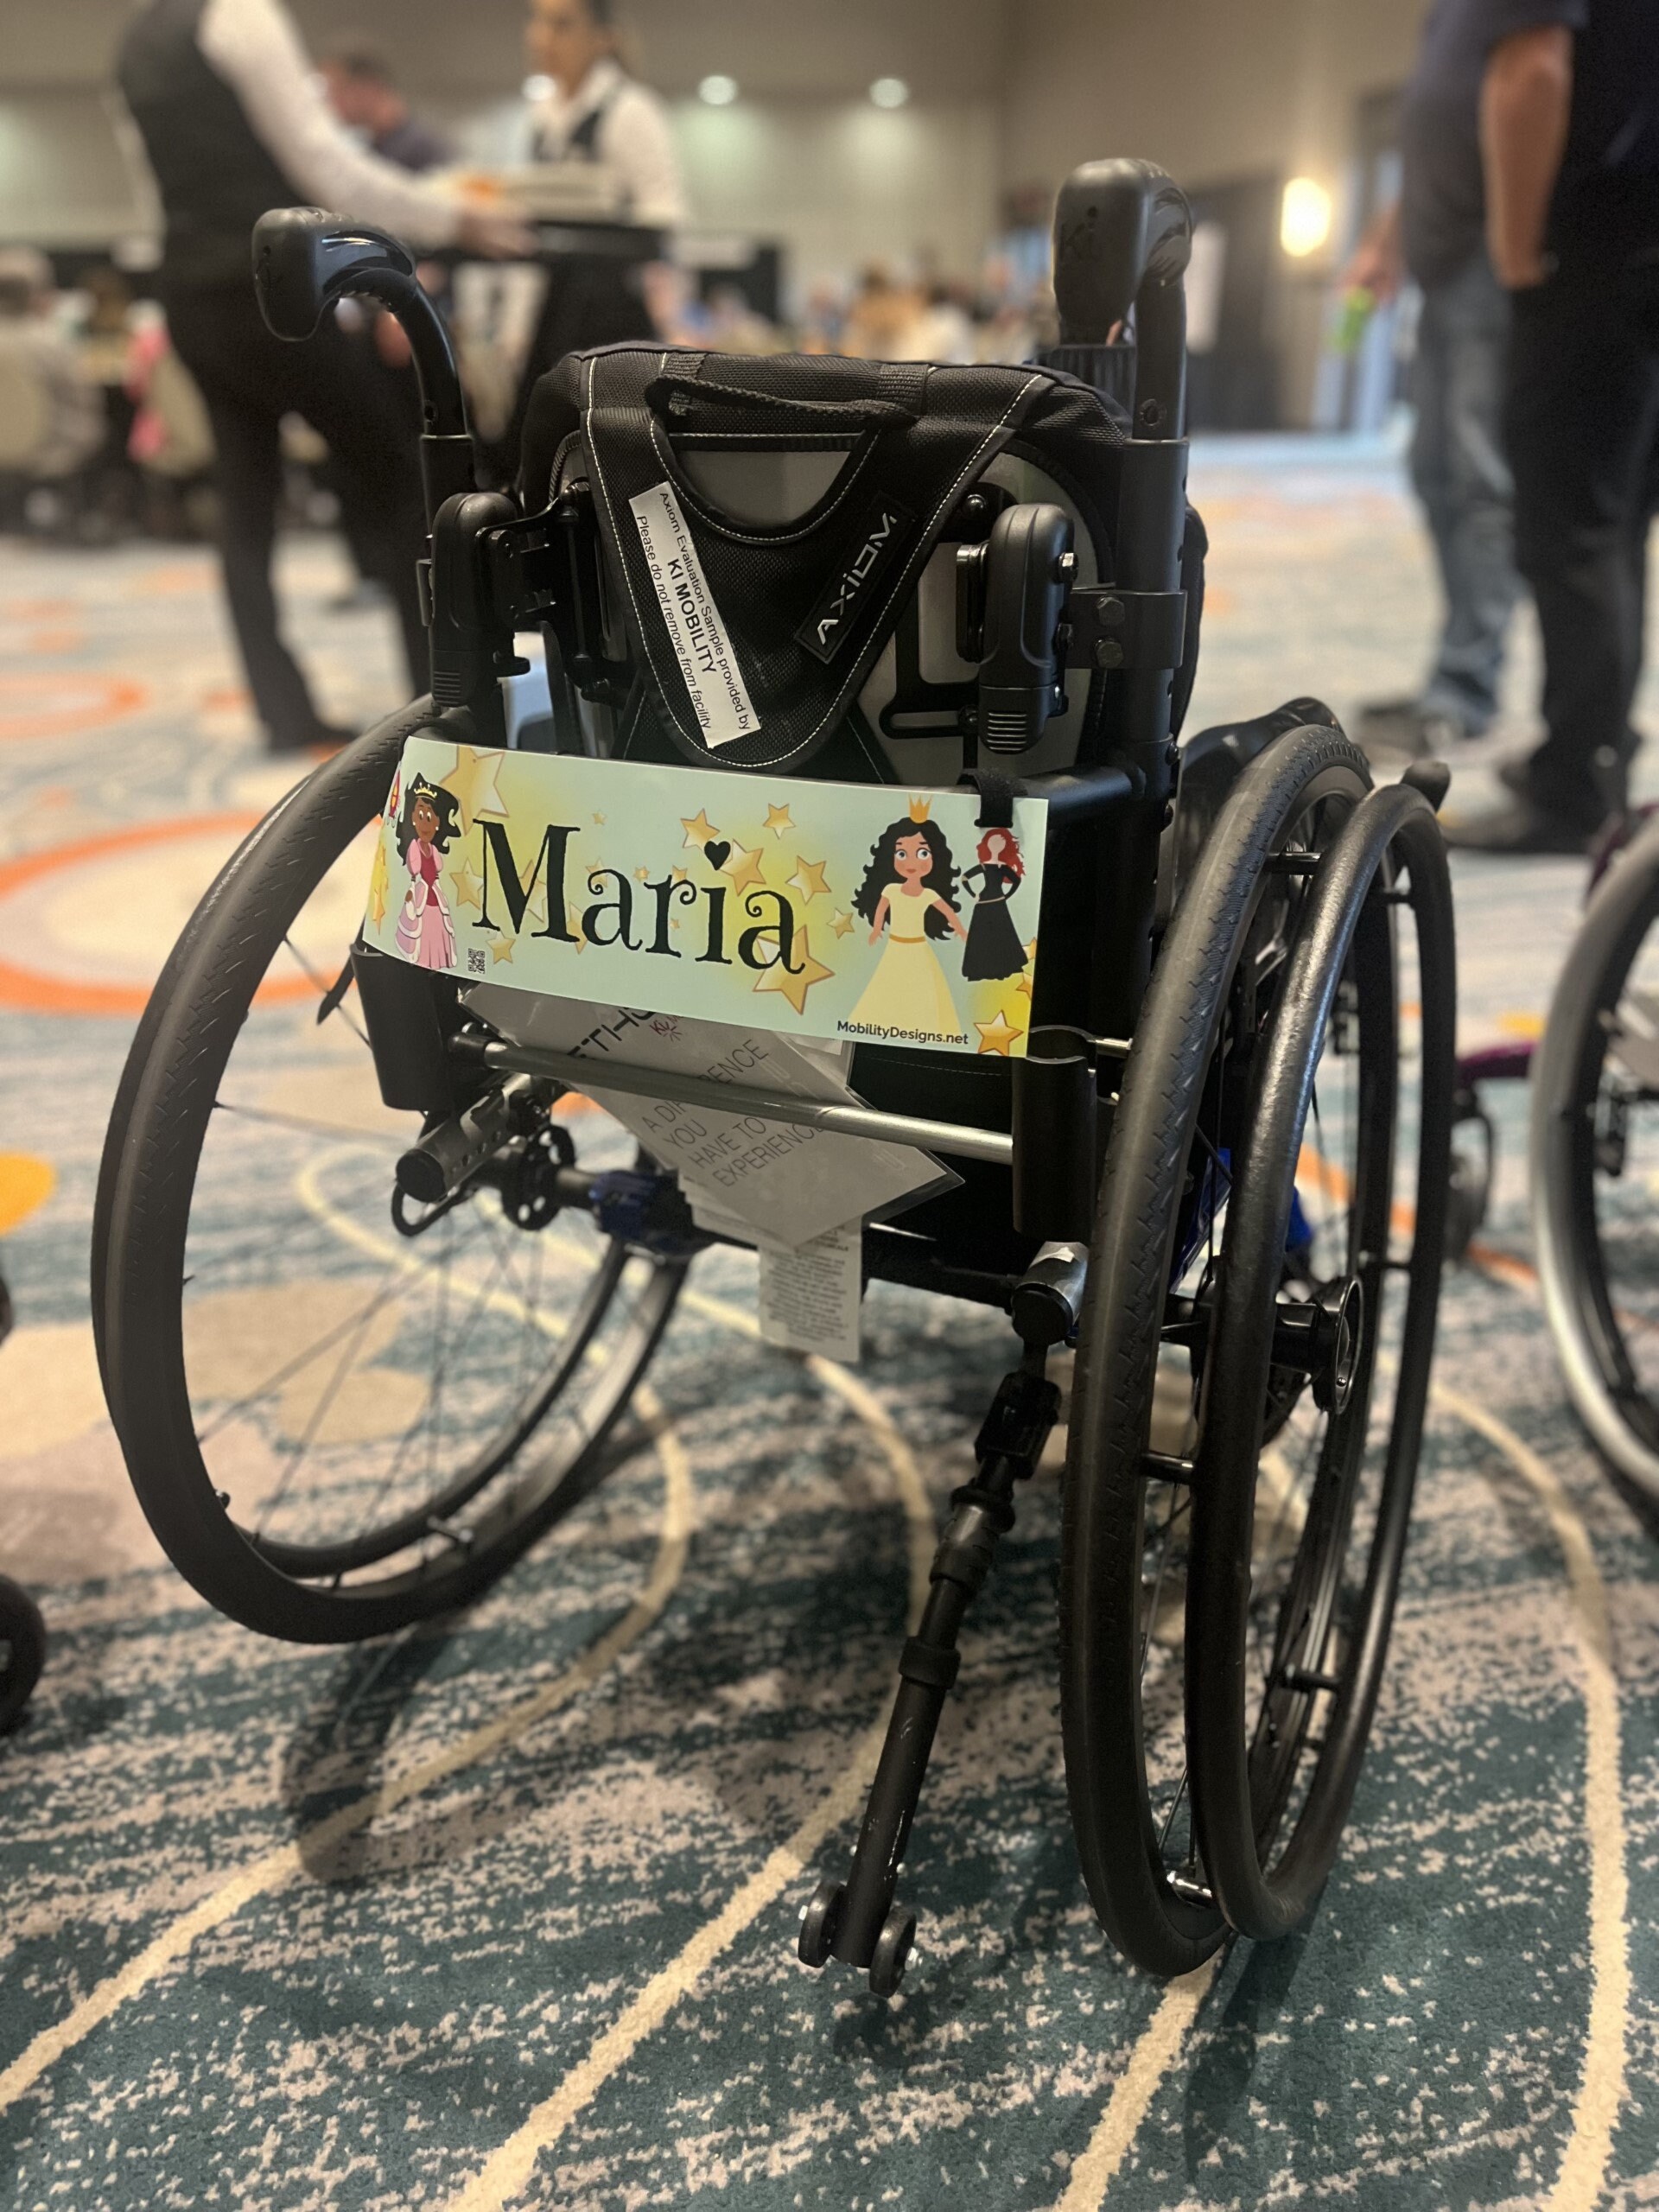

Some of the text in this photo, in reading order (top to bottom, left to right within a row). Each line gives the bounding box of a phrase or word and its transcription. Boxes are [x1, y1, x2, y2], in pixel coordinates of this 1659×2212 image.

[637, 516, 712, 729] Please do not remove from facility
[660, 493, 751, 730] Axiom Evaluation Sample provided by
[667, 558, 717, 673] KI MOBILITY
[472, 817, 806, 975] Maria
[836, 1020, 969, 1045] MobilityDesigns.net
[642, 1116, 663, 1134] A
[663, 1119, 707, 1149] YOU
[688, 1117, 766, 1169] HAVE TO
[712, 1123, 823, 1187] EXPERIENC
